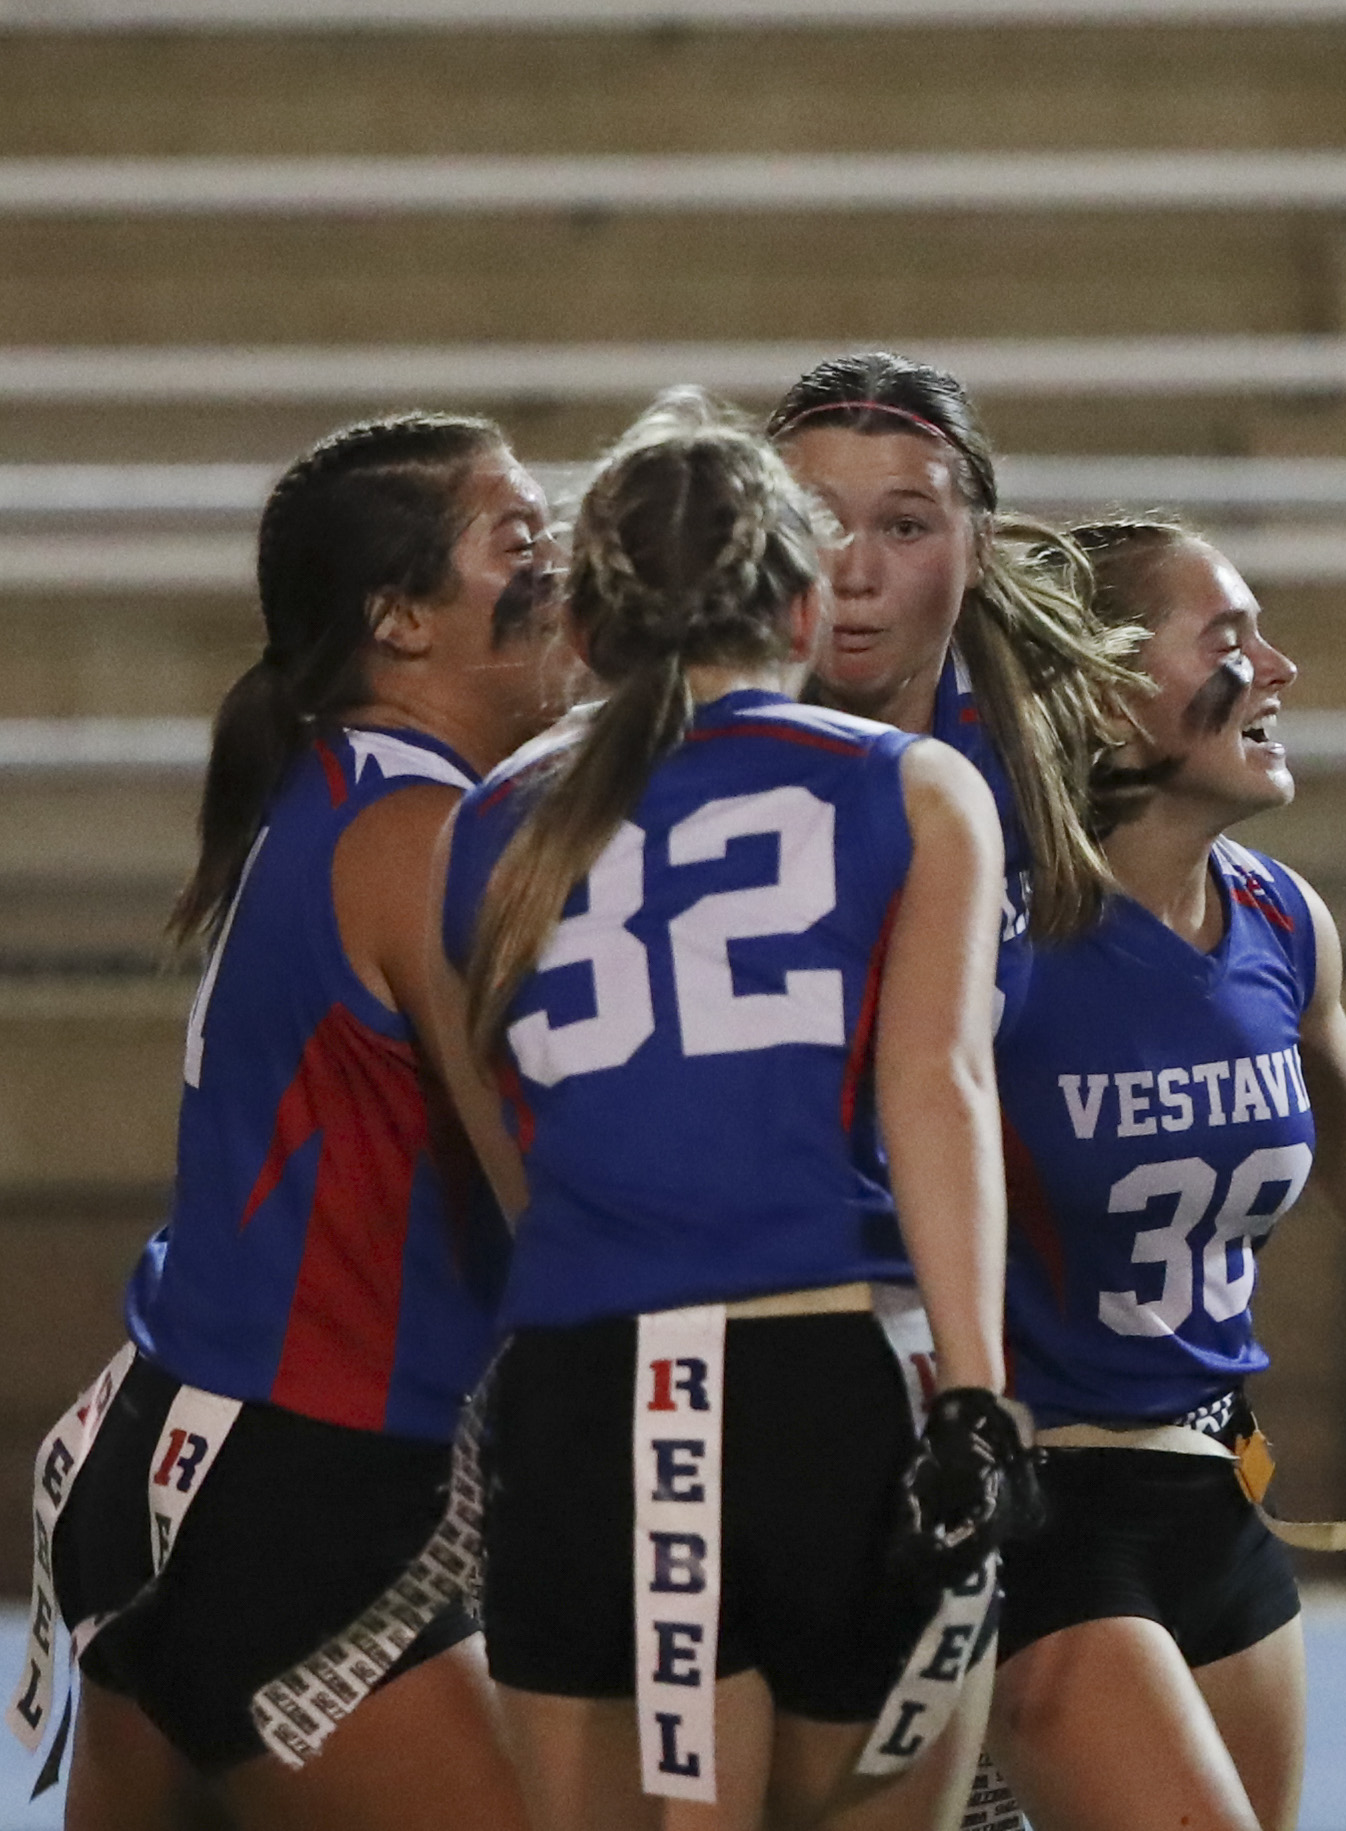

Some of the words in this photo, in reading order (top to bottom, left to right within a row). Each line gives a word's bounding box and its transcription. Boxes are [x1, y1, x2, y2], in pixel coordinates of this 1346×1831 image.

[506, 785, 845, 1088] 32
[1057, 1043, 1311, 1139] VESTAVI
[1098, 1142, 1313, 1337] 38
[646, 1357, 711, 1778] REBEL
